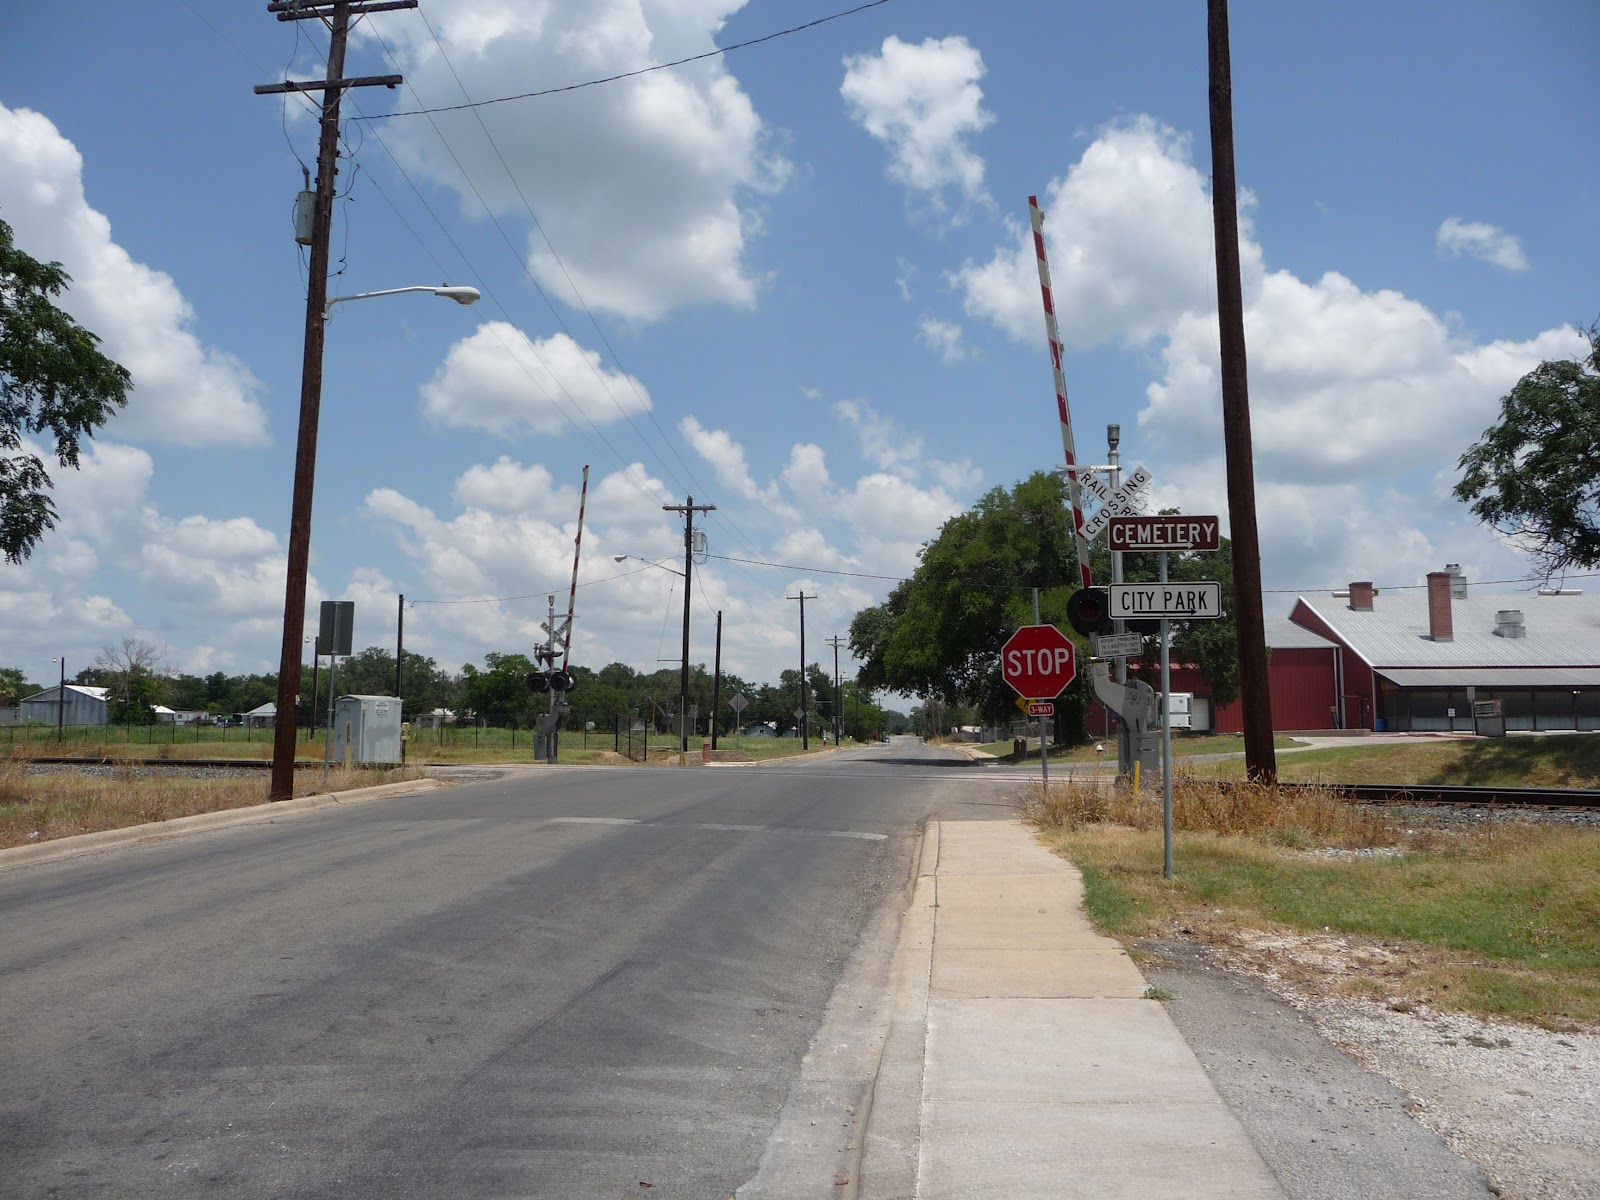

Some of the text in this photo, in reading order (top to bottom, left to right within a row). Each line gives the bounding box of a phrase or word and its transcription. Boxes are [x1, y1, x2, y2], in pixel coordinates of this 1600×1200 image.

[1080, 473, 1108, 500] RAIL
[1085, 472, 1145, 535] CROSSING
[1112, 522, 1215, 544] CEMETERY
[1121, 591, 1208, 611] CITY PARK
[1007, 647, 1070, 677] STOP
[1030, 705, 1052, 714] 3-WAY
